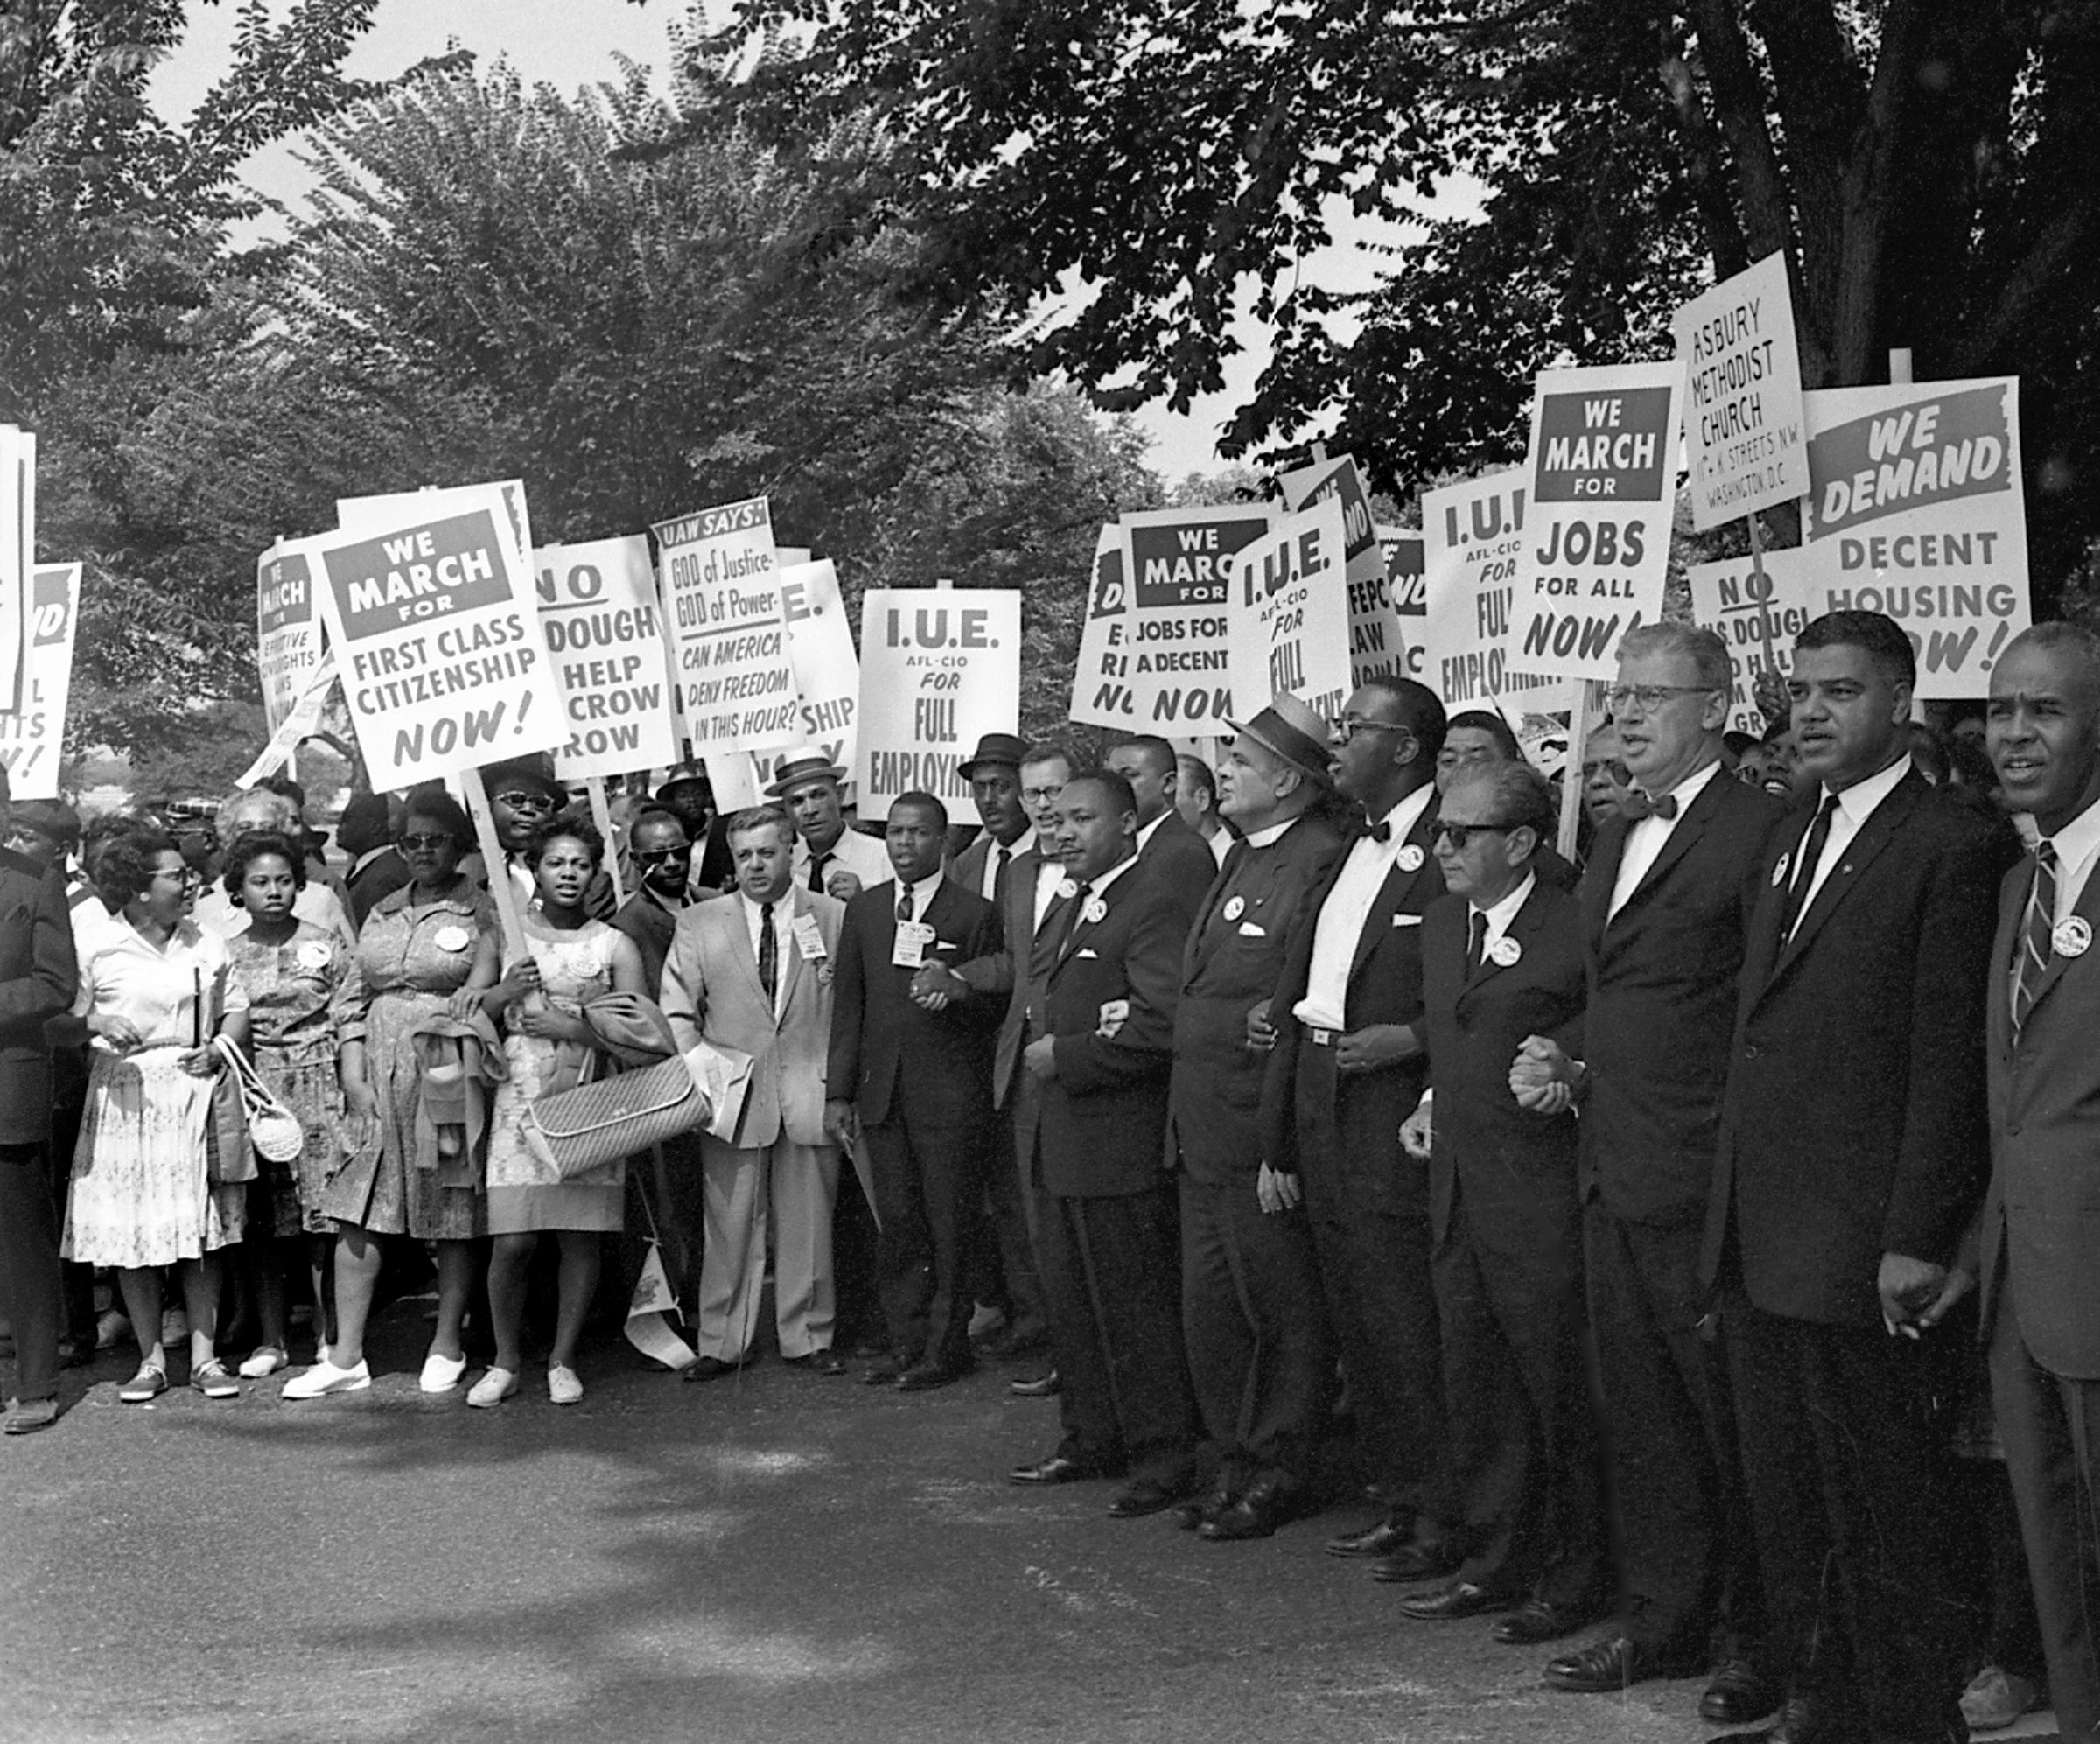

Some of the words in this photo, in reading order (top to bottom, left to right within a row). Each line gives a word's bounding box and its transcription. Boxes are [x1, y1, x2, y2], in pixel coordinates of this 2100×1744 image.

[1694, 298, 1760, 364] ASBURY
[1692, 339, 1773, 408] METHODIST
[1584, 399, 1622, 429] WE
[1701, 392, 1762, 446] CHURCH
[1868, 404, 1940, 461] WE
[1545, 433, 1656, 471] MARCH
[1727, 431, 1774, 470] STREETS
[1574, 478, 1616, 494] FOR
[1821, 436, 2002, 523] DEMAND
[663, 519, 699, 546] UAW
[703, 503, 763, 536] SAYS:
[1178, 529, 1219, 551] WE
[1536, 520, 1646, 567] JOBS
[382, 531, 435, 564] WE
[1840, 532, 1998, 570] DECENT
[348, 548, 493, 613] MARCH
[535, 564, 602, 604] NO
[671, 553, 700, 590] GOD
[704, 550, 718, 582] of
[1144, 553, 1236, 585] MARC
[1245, 528, 1330, 607] I.U.E.
[1480, 558, 1516, 584] FOR
[1180, 586, 1226, 600] FOR
[1260, 588, 1308, 622] AFL-CIO
[1348, 577, 1390, 614] FEPC
[1535, 578, 1578, 596] FOR
[1591, 578, 1634, 598] ALL
[1718, 572, 1773, 603] NO
[1827, 584, 2016, 618] HOUSING
[399, 595, 453, 622] FOR
[676, 592, 706, 627] GOD
[711, 590, 725, 621] of
[1272, 608, 1303, 641] FOR
[353, 637, 427, 681] FIRST
[438, 614, 524, 658] CLASS
[544, 606, 655, 653] DOUGH
[886, 609, 999, 648] I.U.E.
[1137, 620, 1185, 641] JOBS
[682, 644, 711, 670] CAN
[714, 632, 780, 659] AMERICA
[906, 656, 968, 667] AFL-CIO
[1138, 654, 1153, 673] A
[1156, 650, 1228, 672] DECENT
[1269, 639, 1306, 698] FULL
[357, 648, 536, 715] CITIZENSHIP
[564, 656, 641, 690] HELP
[689, 680, 720, 706] DENY
[723, 669, 789, 699] FREEDOM
[920, 672, 961, 690] FOR
[569, 684, 660, 721] CROW
[695, 718, 710, 743] IN
[712, 712, 738, 739] THIS
[742, 700, 797, 737] HOUR?
[915, 697, 957, 742] FULL
[394, 690, 533, 767] NOW!
